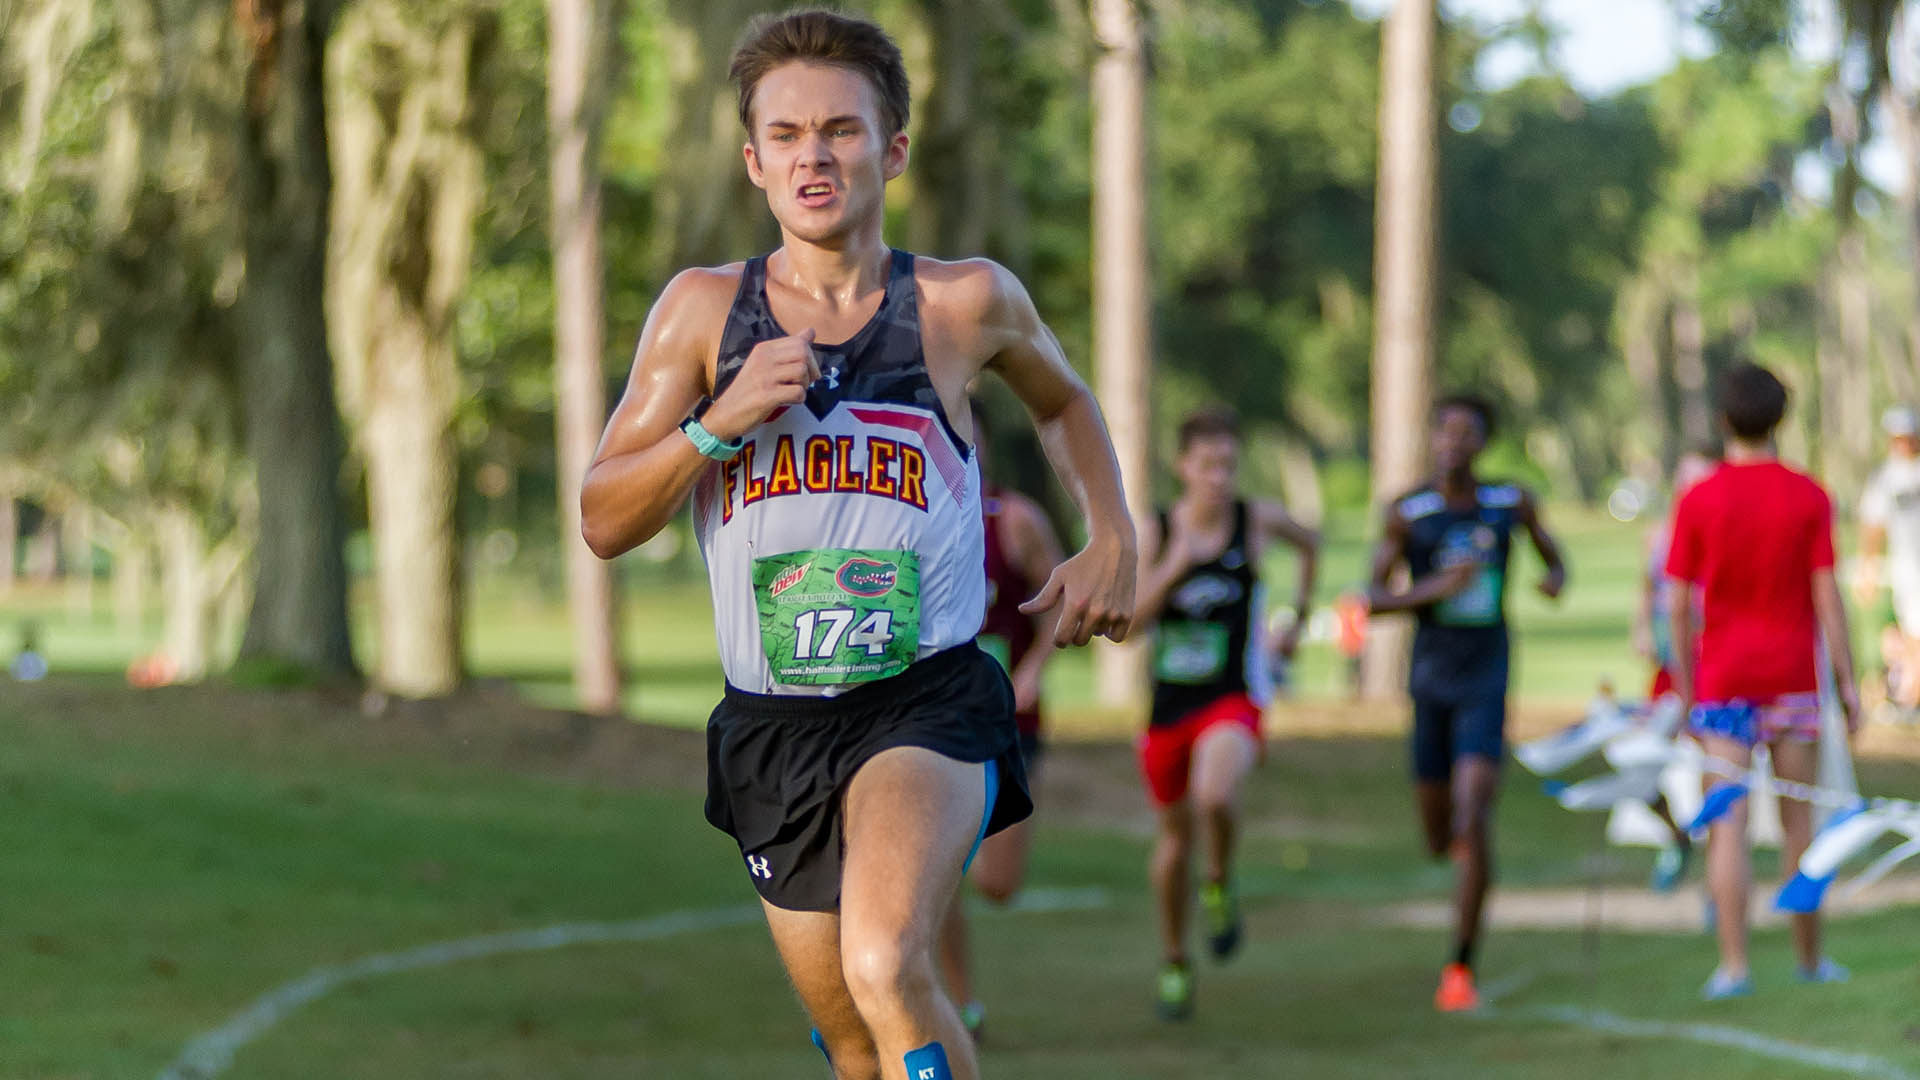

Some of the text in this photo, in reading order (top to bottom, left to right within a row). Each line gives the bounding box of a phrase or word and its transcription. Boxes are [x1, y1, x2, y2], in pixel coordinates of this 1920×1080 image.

[722, 434, 928, 526] FLAGLER
[794, 608, 894, 660] 174
[780, 660, 901, 676] www.halfmiletiming.com
[918, 1067, 935, 1080] KT
